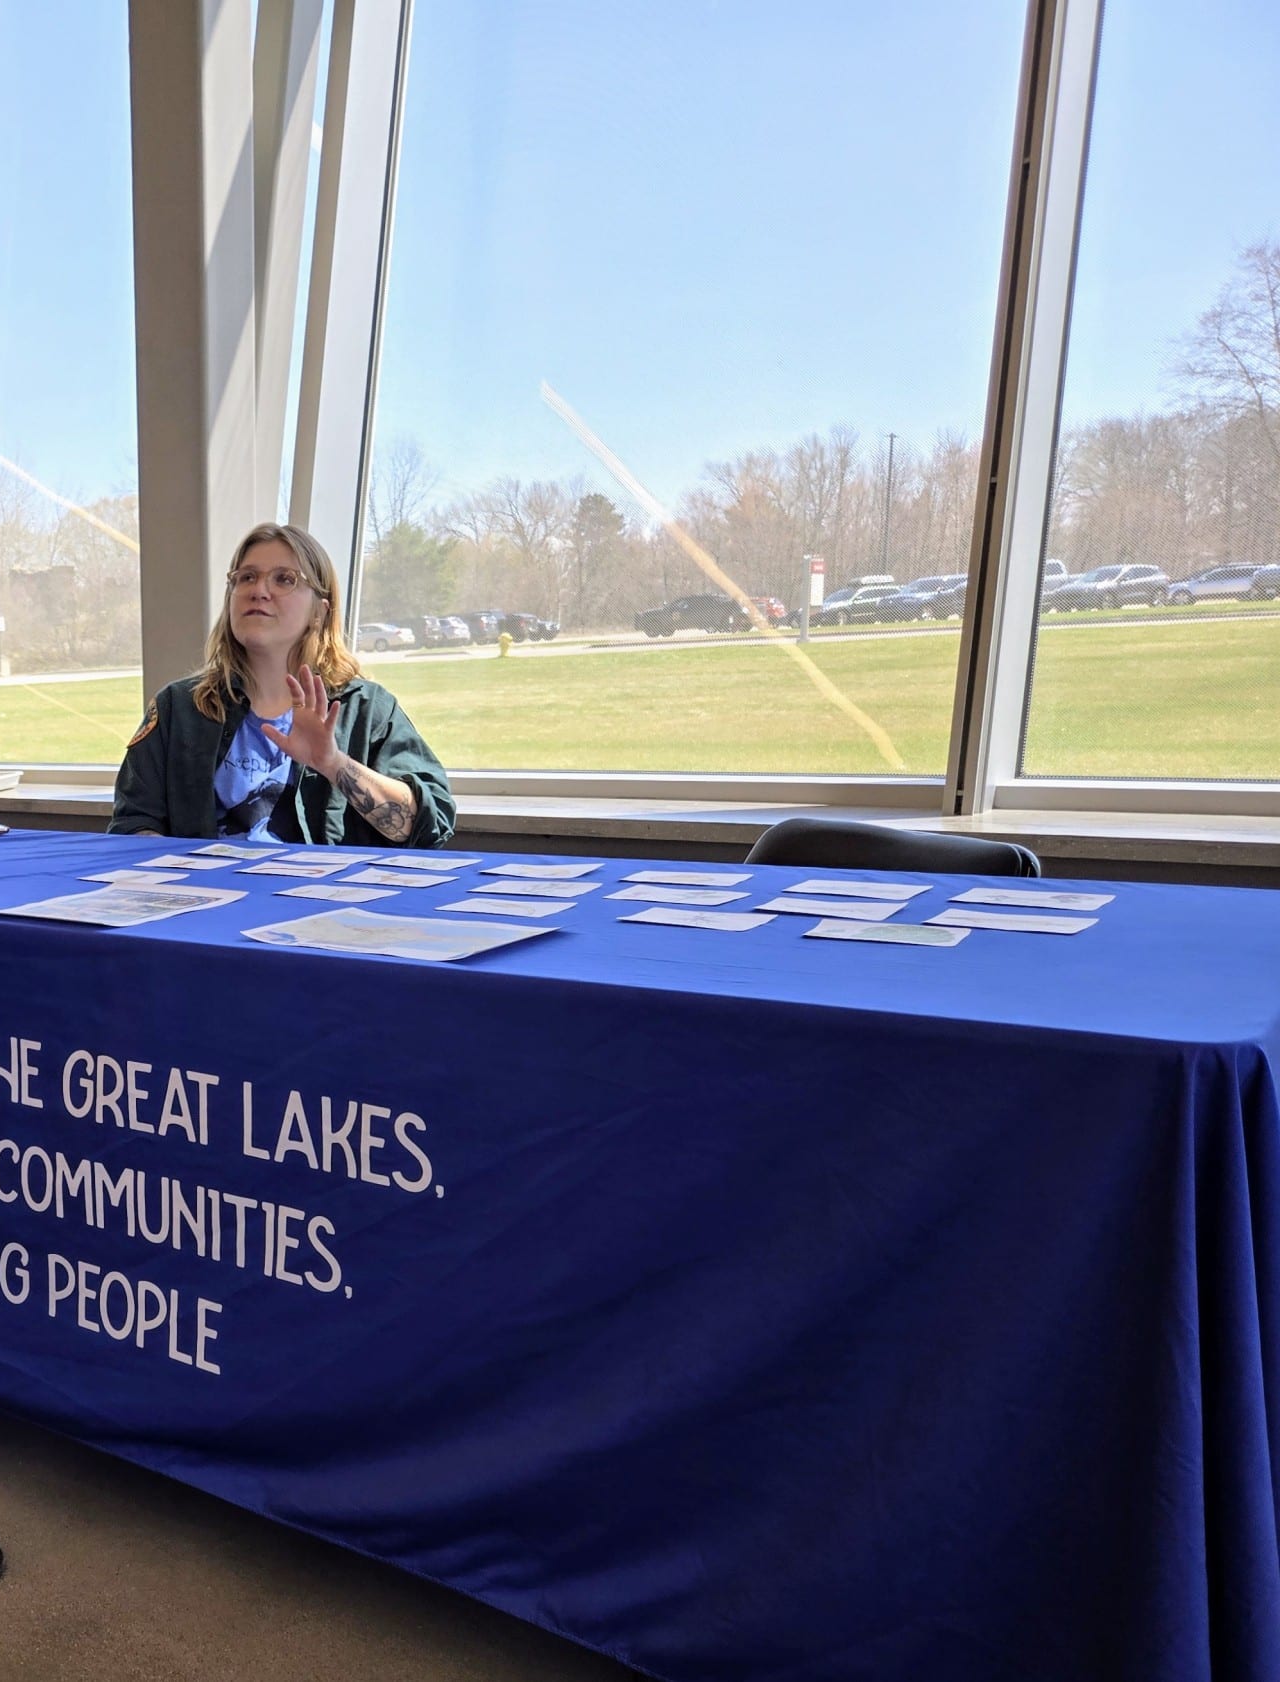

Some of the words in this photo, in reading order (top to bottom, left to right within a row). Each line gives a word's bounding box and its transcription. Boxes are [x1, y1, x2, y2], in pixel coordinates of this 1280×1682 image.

[62, 1049, 220, 1145] GREAT
[243, 1081, 444, 1198] LAKES,
[48, 1253, 223, 1375] PEOPLE
